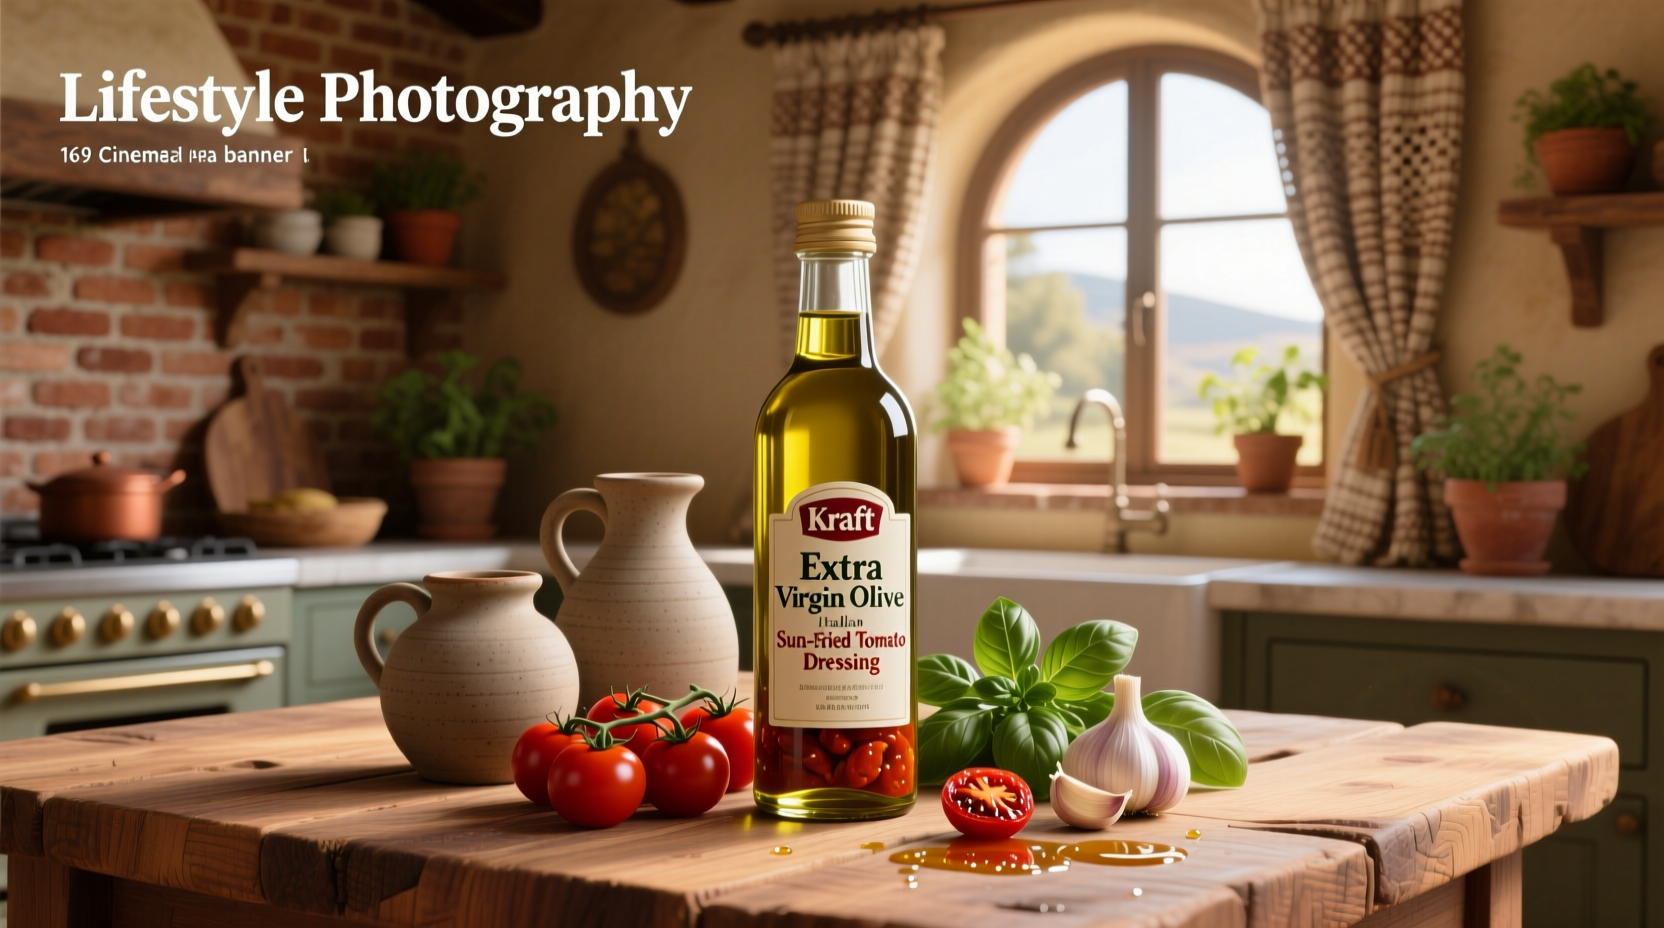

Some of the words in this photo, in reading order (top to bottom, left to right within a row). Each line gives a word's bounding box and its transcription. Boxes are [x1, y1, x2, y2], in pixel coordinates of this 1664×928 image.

[808, 505, 875, 531] Kraft
[800, 552, 882, 580] Extra
[775, 585, 845, 614] Virgin
[850, 585, 904, 608] Olive
[855, 631, 906, 648] Tomato
[803, 652, 880, 675] Dressing
